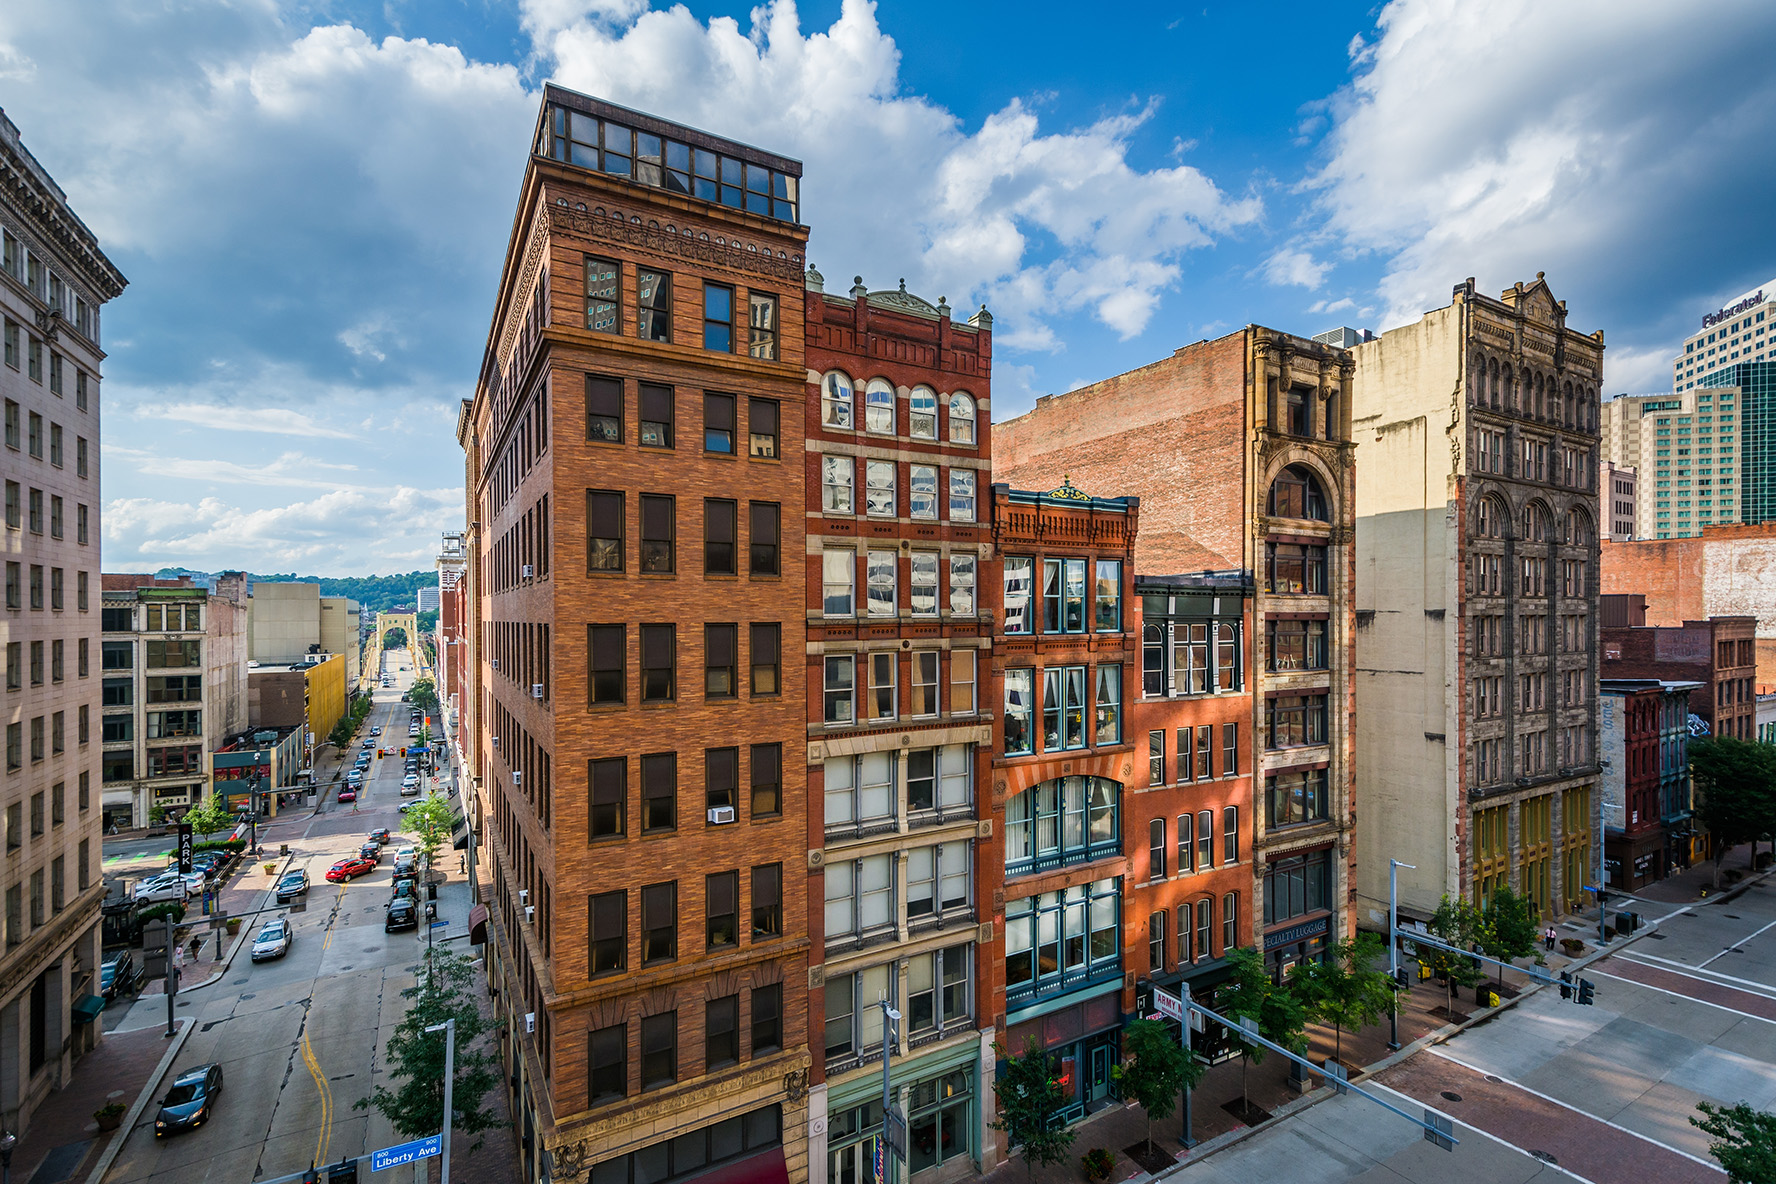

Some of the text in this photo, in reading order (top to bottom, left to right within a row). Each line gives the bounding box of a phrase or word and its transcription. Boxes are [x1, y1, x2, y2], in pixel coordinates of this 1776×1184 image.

[1702, 290, 1763, 329] Federated
[182, 833, 191, 865] PARK
[1263, 919, 1327, 948] PECIALTY LUGGAGE
[1157, 993, 1176, 1010] ARMY
[1177, 1003, 1196, 1021] NY
[425, 1138, 438, 1146] 900
[376, 1146, 437, 1168] Liberty Ave
